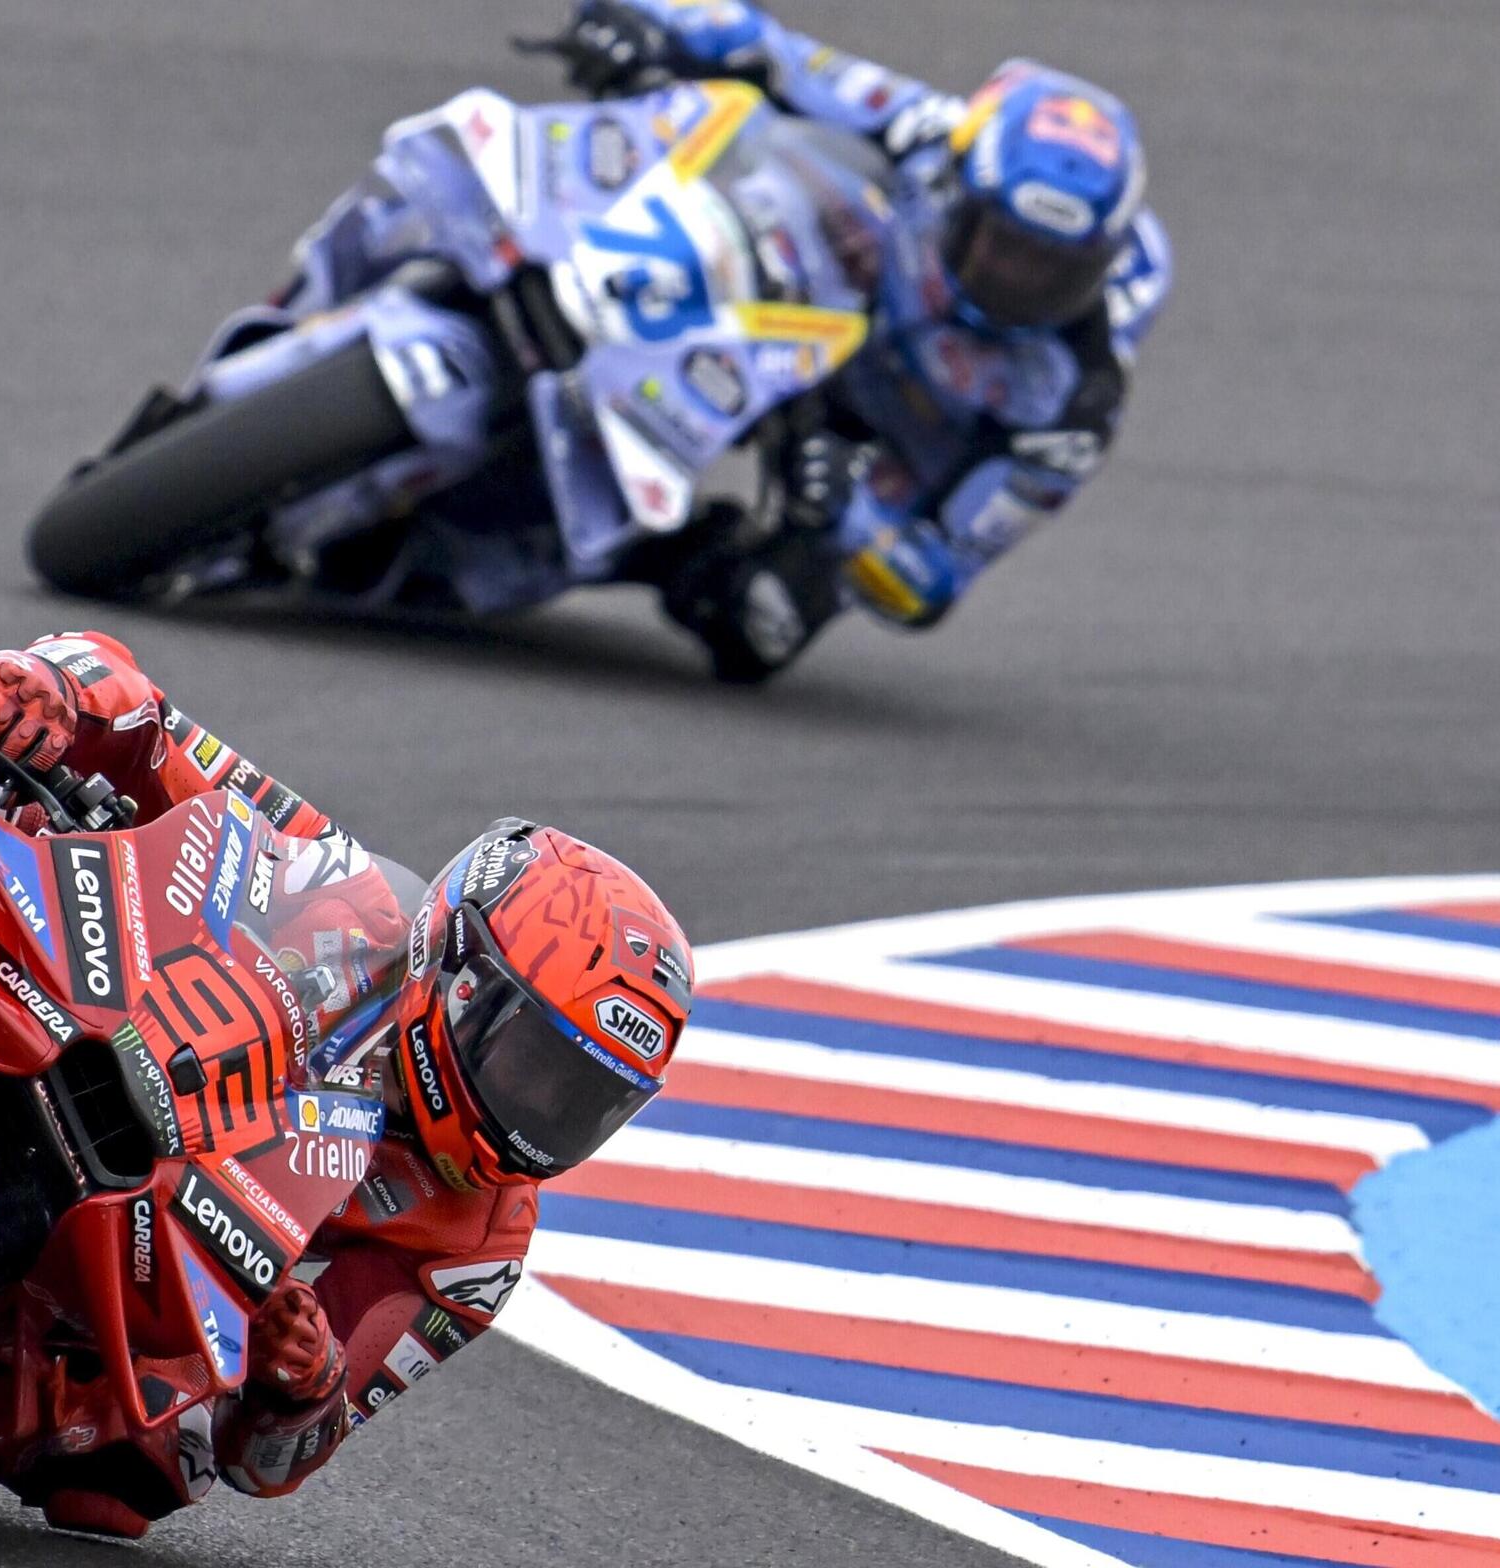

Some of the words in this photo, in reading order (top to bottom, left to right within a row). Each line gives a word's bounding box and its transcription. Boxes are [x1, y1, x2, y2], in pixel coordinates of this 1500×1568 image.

[579, 194, 716, 343] 73
[165, 813, 215, 917] riello
[483, 837, 517, 890] Estrella
[9, 876, 46, 933] TIM
[70, 848, 111, 997] Lenovo
[121, 839, 152, 982] FRECCIAROSSA
[412, 909, 428, 972] SHOEI
[255, 956, 305, 1066] VARGROUP
[605, 1004, 661, 1054] SHOEI
[411, 1024, 443, 1111] Lenovo
[583, 1041, 616, 1071] Estrella
[135, 1048, 180, 1155] MONSTER
[327, 1103, 380, 1134] ADVANCE
[306, 1135, 366, 1182] riello
[508, 1130, 554, 1166] Insta360
[181, 1174, 274, 1285] Lenovo
[220, 1158, 308, 1246] FRECCIAROSSA
[373, 1176, 397, 1213] Lenovo
[134, 1200, 151, 1283] CARRERA
[203, 1310, 225, 1369] TIM
